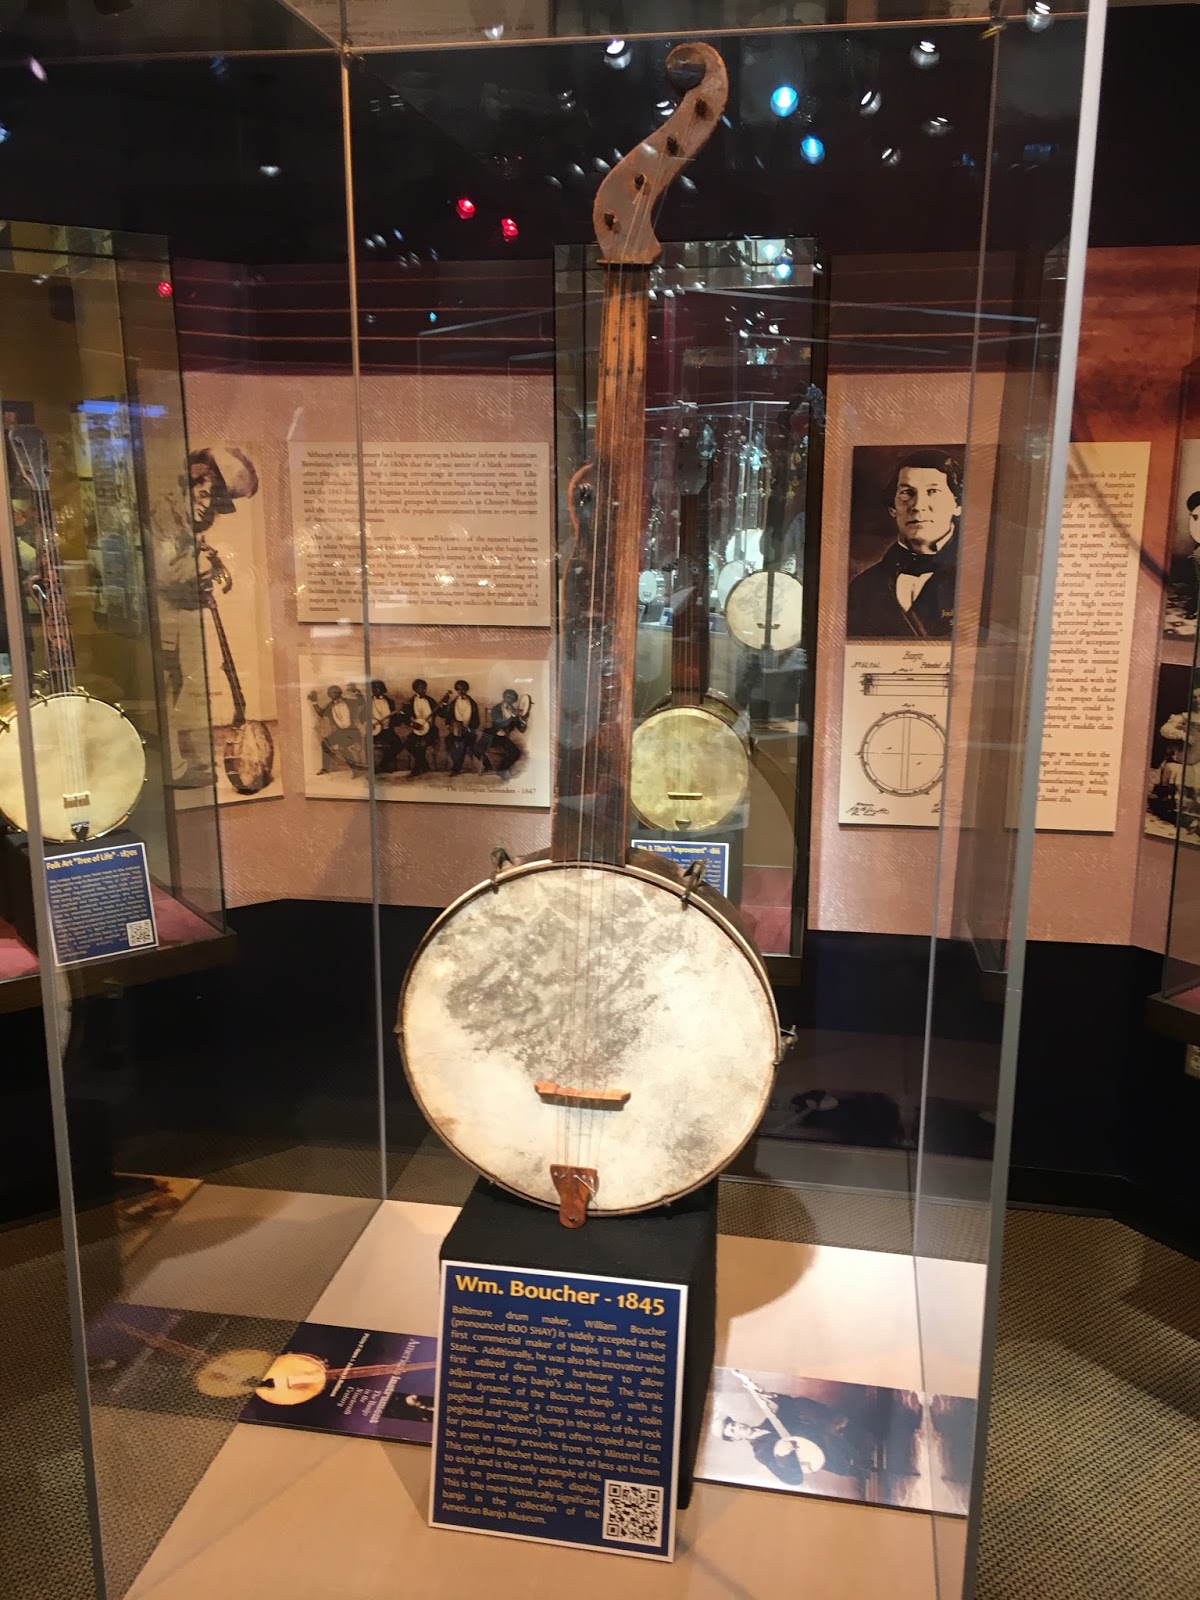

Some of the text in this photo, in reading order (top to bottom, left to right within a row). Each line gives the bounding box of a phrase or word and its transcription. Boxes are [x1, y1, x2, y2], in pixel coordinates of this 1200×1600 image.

[1063, 571, 1091, 579] resulting
[1089, 561, 1128, 569] sociological
[46, 861, 61, 870] Folk
[62, 859, 74, 867] Art
[92, 854, 100, 863] of
[454, 1273, 504, 1295] Wm.
[510, 1279, 600, 1305] Boucher
[616, 1291, 665, 1316] 1845
[450, 1317, 505, 1333] (pronounced
[507, 1323, 528, 1333] BOO
[529, 1326, 556, 1338] SHAY)
[558, 1329, 565, 1338] is
[567, 1330, 595, 1343] widely
[596, 1333, 637, 1347] accepted
[650, 1339, 666, 1349] the
[451, 1305, 666, 1336] Baltimore drum maker, William Boucher
[450, 1329, 665, 1362] first commercial maker of banjos in the United
[450, 1342, 478, 1352] States.
[482, 1345, 534, 1361] Additionally,
[535, 1351, 546, 1360] he
[566, 1355, 584, 1365] also
[585, 1357, 600, 1367] the
[601, 1359, 643, 1372] innovator
[645, 1364, 664, 1374] who
[448, 1366, 495, 1381] adjustment
[498, 1372, 508, 1381] of
[512, 1374, 527, 1383] the
[564, 1380, 582, 1390] skin
[585, 1382, 609, 1393] head.
[618, 1386, 634, 1396] The
[637, 1389, 663, 1400] iconic
[449, 1354, 663, 1387] first utilized drum type hardware to allow
[369, 1375, 401, 1423] Instrument
[447, 1378, 472, 1389] visual
[475, 1382, 511, 1396] dynamic
[515, 1387, 526, 1396] of
[529, 1388, 545, 1398] the
[549, 1391, 585, 1403] Boucher
[589, 1396, 614, 1408] banjo
[626, 1400, 647, 1411] with
[651, 1404, 663, 1413] its
[447, 1391, 483, 1405] peghead
[489, 1396, 528, 1410] mirroring
[546, 1405, 568, 1414] cross
[574, 1407, 605, 1418] section
[611, 1411, 621, 1420] of
[638, 1414, 662, 1425] violin
[445, 1415, 459, 1425] for
[460, 1417, 495, 1431] position
[496, 1422, 542, 1437] reference)
[548, 1430, 566, 1438] was
[568, 1431, 592, 1442] often
[594, 1434, 624, 1448] copied
[625, 1438, 643, 1448] and
[644, 1443, 661, 1451] can
[446, 1403, 483, 1417] peghead
[484, 1408, 501, 1418] and
[535, 1414, 564, 1428] (bump
[565, 1418, 574, 1427] in
[575, 1419, 591, 1429] the
[592, 1421, 610, 1432] side
[611, 1424, 622, 1433] of
[623, 1425, 639, 1435] the
[640, 1427, 661, 1438] neck
[445, 1427, 660, 1463] be seen in many artworks from the Minstrel Era.
[445, 1440, 462, 1450] This
[463, 1442, 494, 1456] original
[496, 1447, 531, 1459] Boucher
[533, 1452, 557, 1464] banjo
[559, 1455, 566, 1464] is
[567, 1458, 584, 1466] one
[586, 1458, 596, 1468] of
[598, 1460, 614, 1470] less
[630, 1464, 659, 1476] known
[444, 1453, 601, 1481] to exist and is the only example of his
[444, 1464, 464, 1475] work
[486, 1471, 532, 1486] permanent
[538, 1477, 562, 1490] public
[569, 1481, 599, 1495] display.
[442, 1489, 600, 1519] banjo in the collection of the
[443, 1476, 600, 1508] This is the most historically significant
[442, 1501, 546, 1524] American Banjo Museum.
